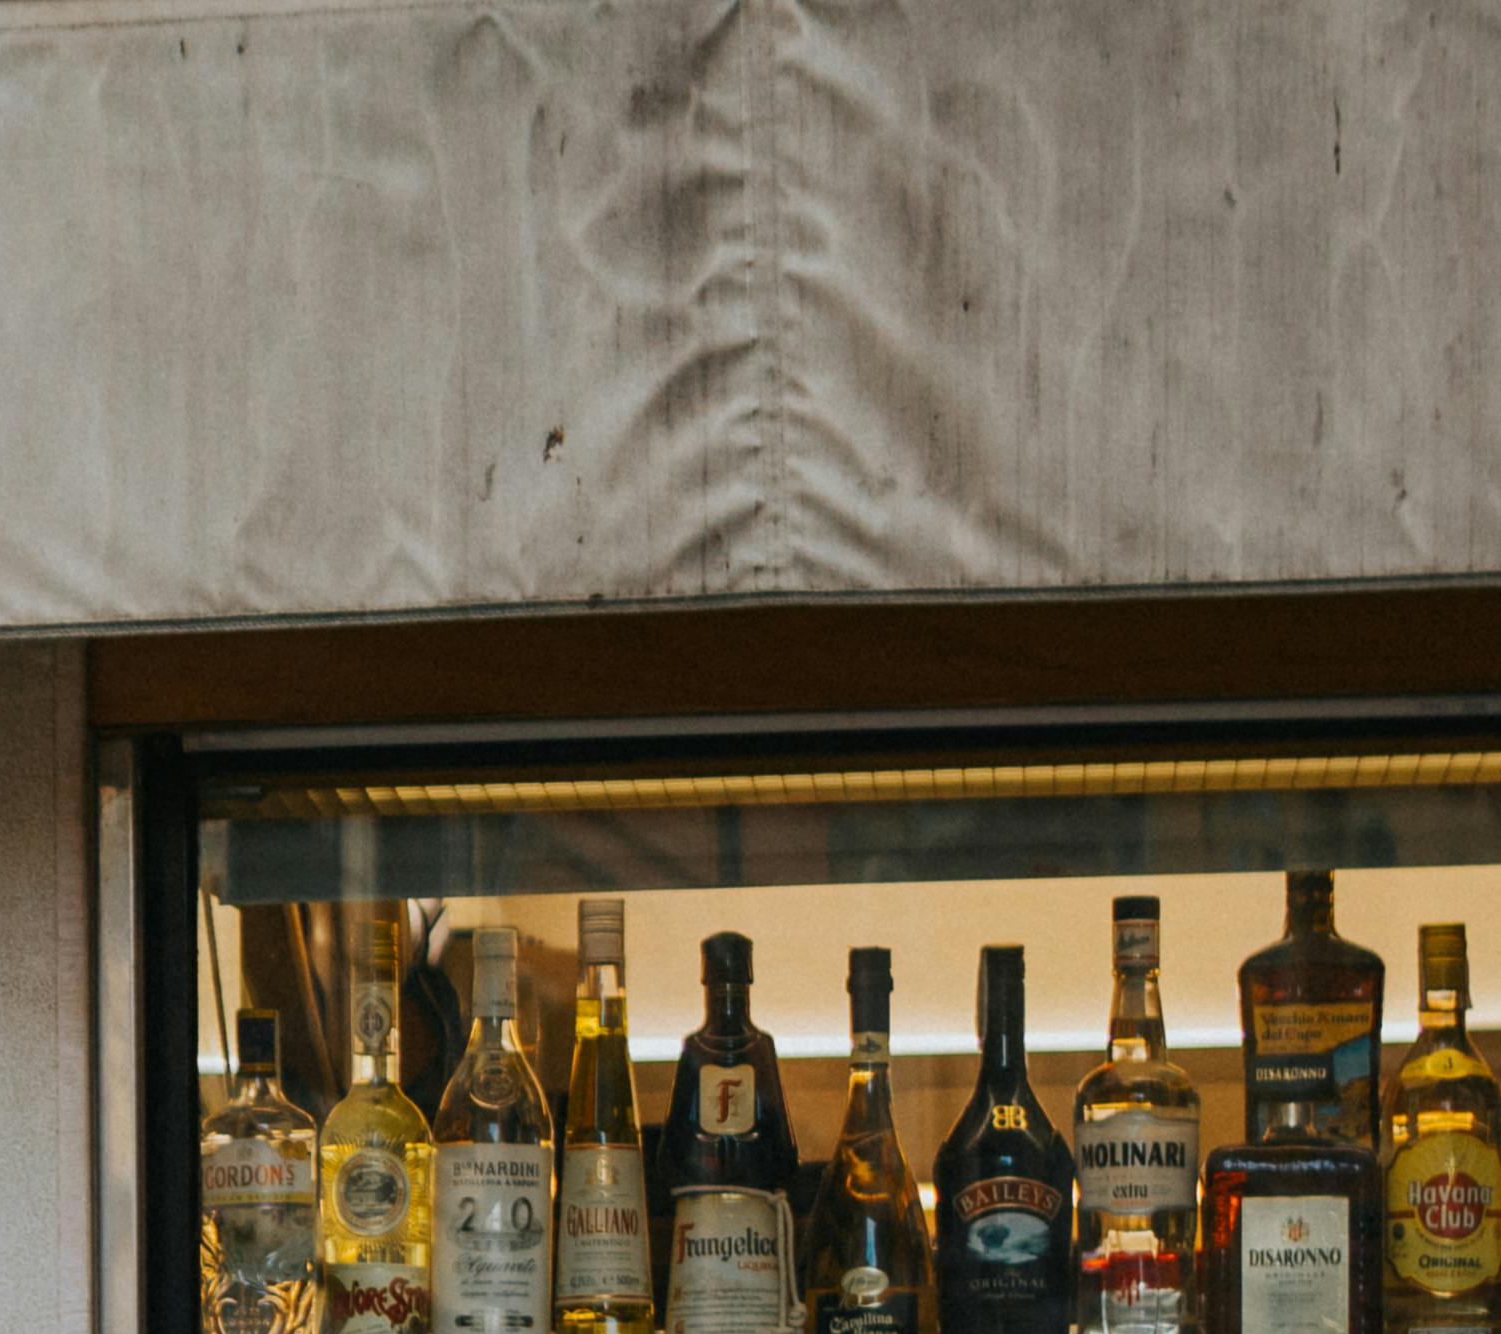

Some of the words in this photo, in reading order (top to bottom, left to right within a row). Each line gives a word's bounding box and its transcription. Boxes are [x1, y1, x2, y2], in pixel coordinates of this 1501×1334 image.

[1255, 1065, 1328, 1082] DISARONNO
[1081, 1141, 1186, 1170] MOLINARI
[204, 1161, 296, 1192] GORDON'S
[959, 1179, 1060, 1213] BAILEYS
[1112, 1180, 1149, 1199] extra
[1408, 1181, 1493, 1206] Havana
[567, 1204, 639, 1238] GALLIANO
[1425, 1204, 1476, 1230] Club
[1248, 1247, 1342, 1269] DISARONNO
[1419, 1255, 1483, 1269] ORIGINAL
